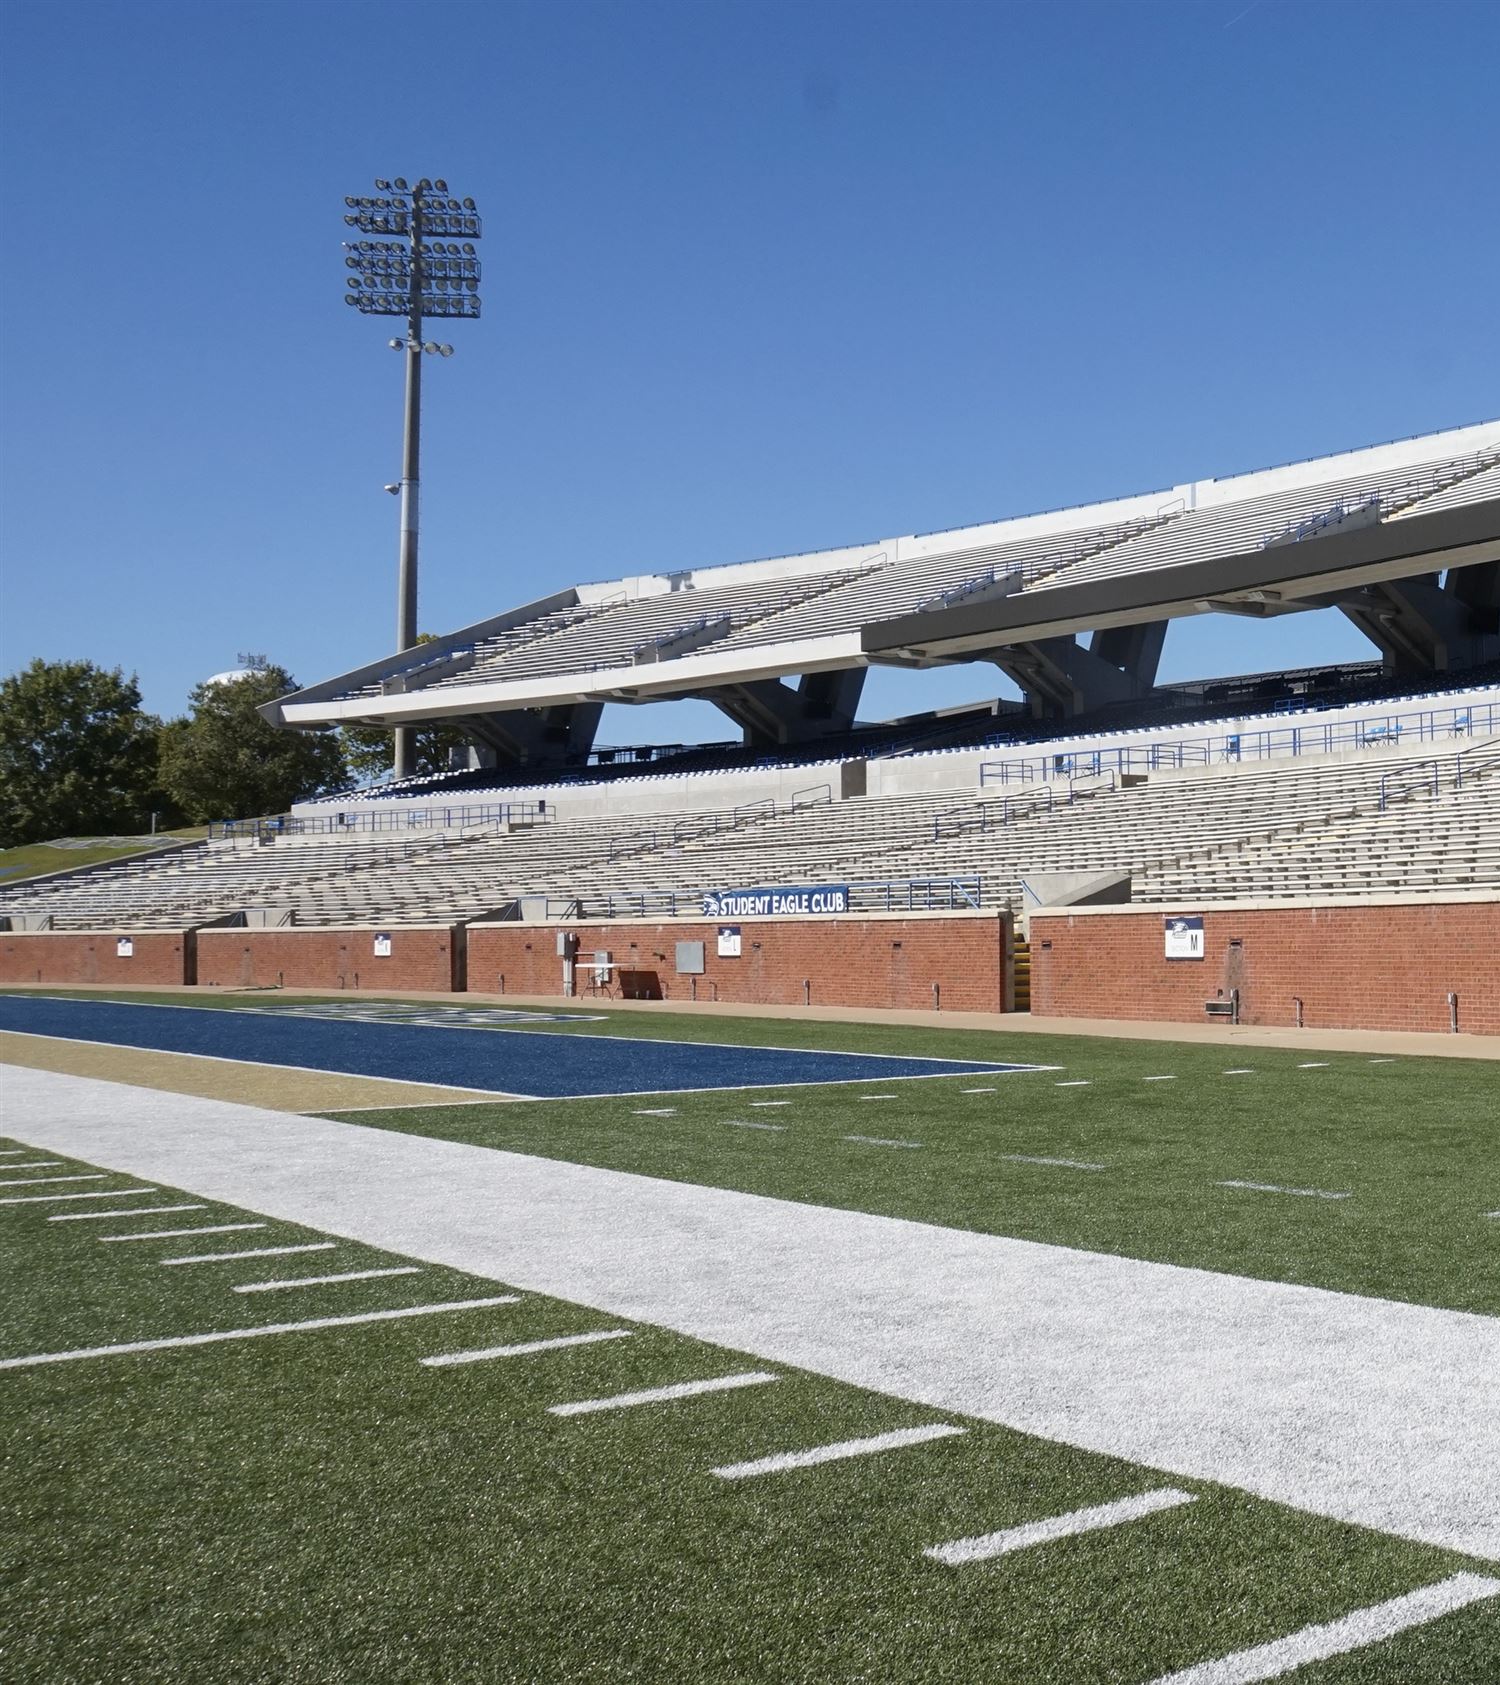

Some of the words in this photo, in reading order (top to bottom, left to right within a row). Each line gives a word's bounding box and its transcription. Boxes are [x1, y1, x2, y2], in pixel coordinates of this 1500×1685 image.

[720, 896, 770, 915] STUDENT
[772, 895, 809, 914] EAGLE
[811, 893, 844, 912] CLUB
[1191, 934, 1198, 951] M
